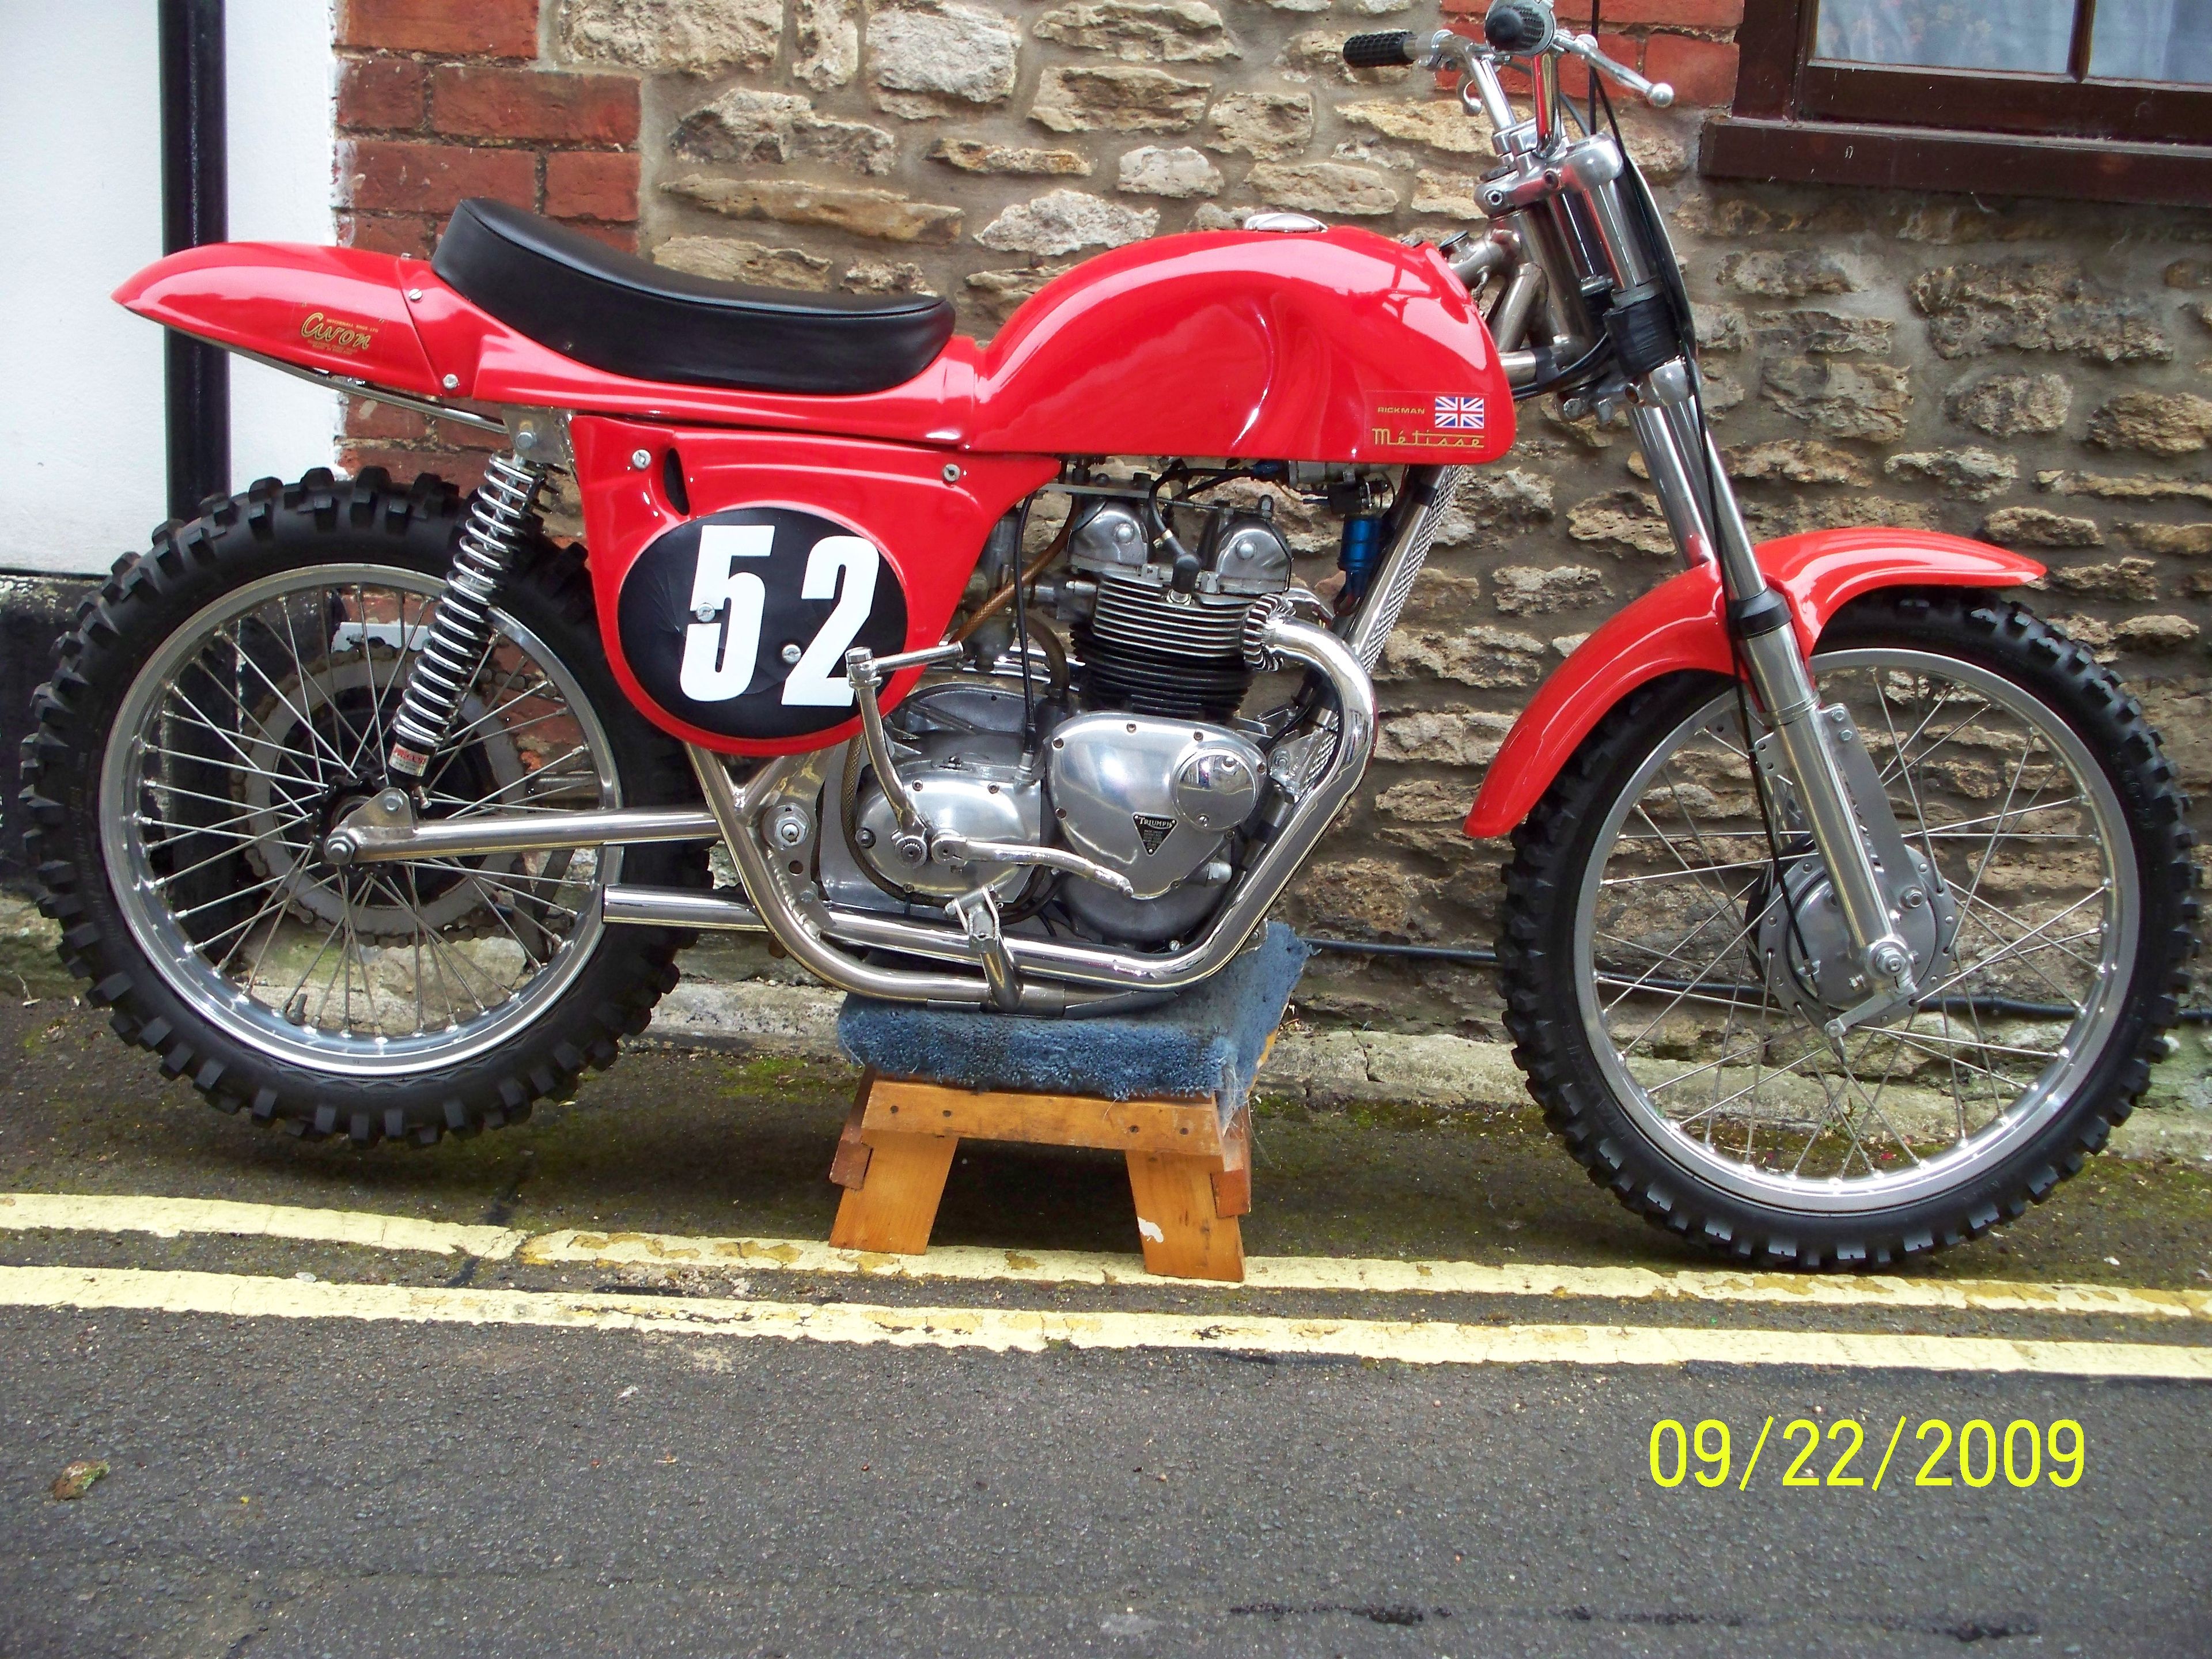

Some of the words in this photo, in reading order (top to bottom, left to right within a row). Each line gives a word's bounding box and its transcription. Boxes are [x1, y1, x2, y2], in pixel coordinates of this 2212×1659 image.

[301, 312, 371, 350] Avon
[680, 525, 880, 706] 52
[1139, 817, 1173, 828] TRIUMPH
